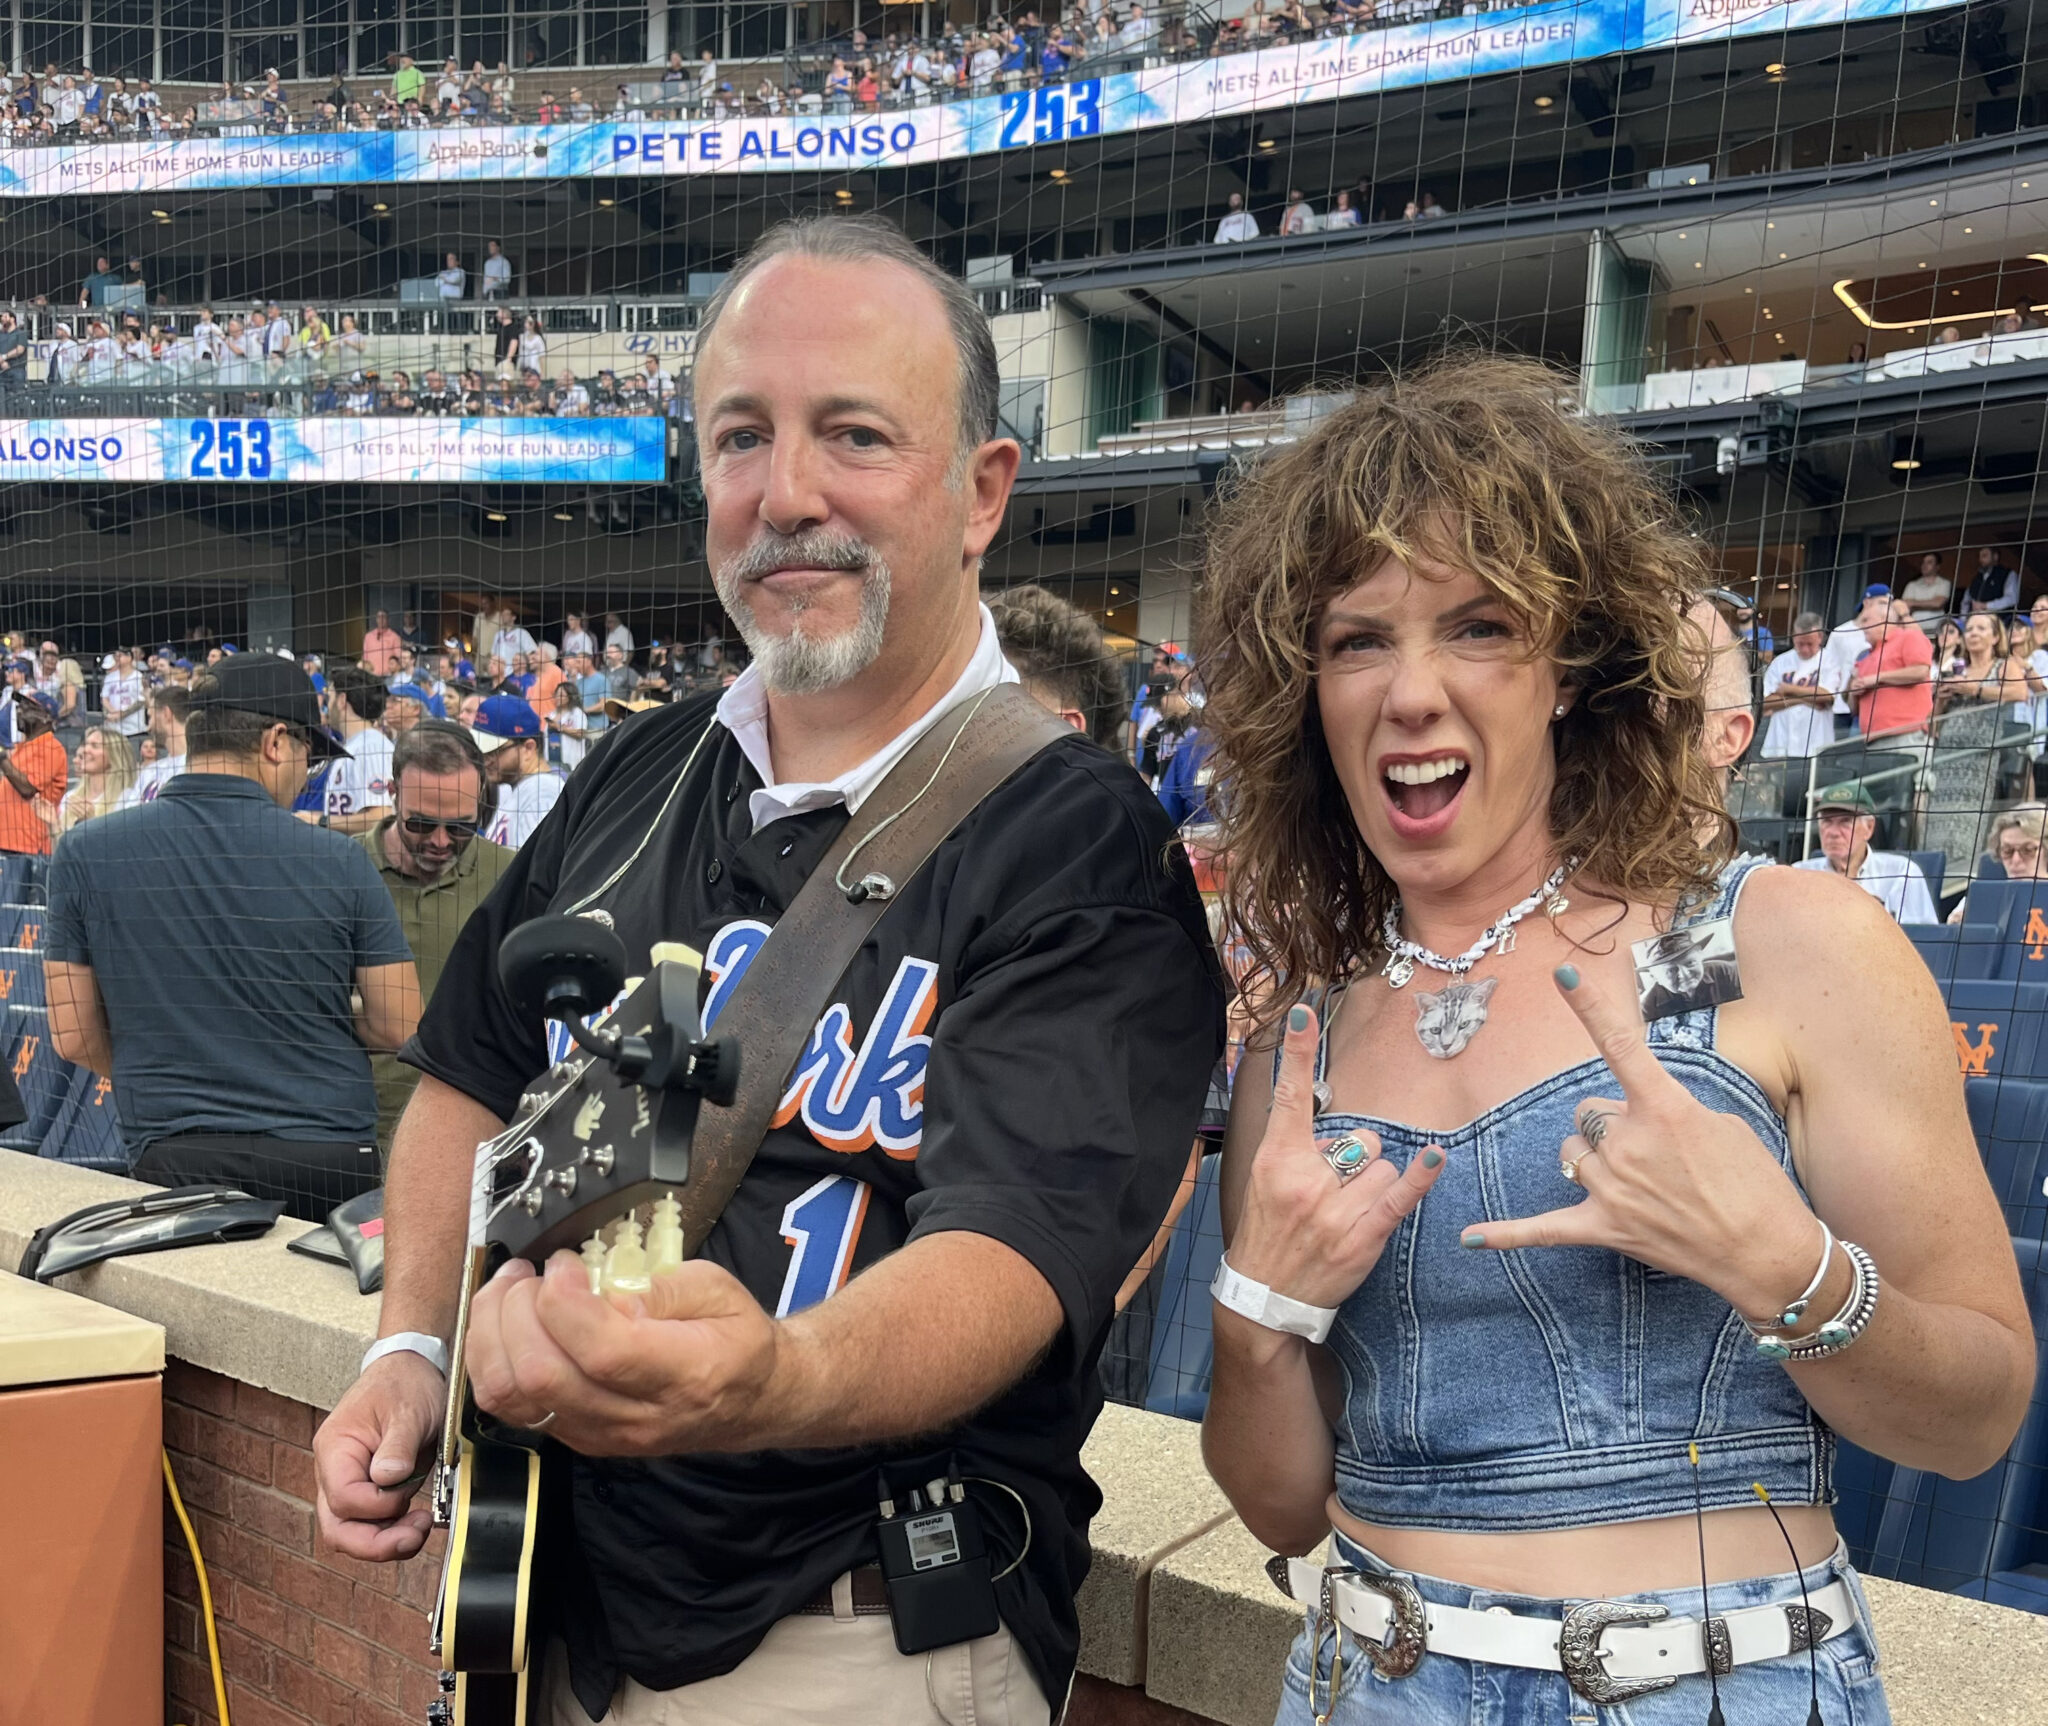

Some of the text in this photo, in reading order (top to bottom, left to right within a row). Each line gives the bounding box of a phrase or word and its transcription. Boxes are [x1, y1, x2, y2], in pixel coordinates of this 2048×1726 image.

[1207, 22, 1574, 96] METS ALL-TIME HOME RUN LEADER
[1000, 77, 1100, 148] 253
[613, 122, 917, 162] PETE ALONSO
[60, 151, 344, 177] METS ALL-TIME HOME RUN LEADER
[190, 420, 271, 478] 253
[354, 442, 617, 456] METS ALL-TIME HOME RUN LEADER
[913, 1516, 944, 1529] SHURE
